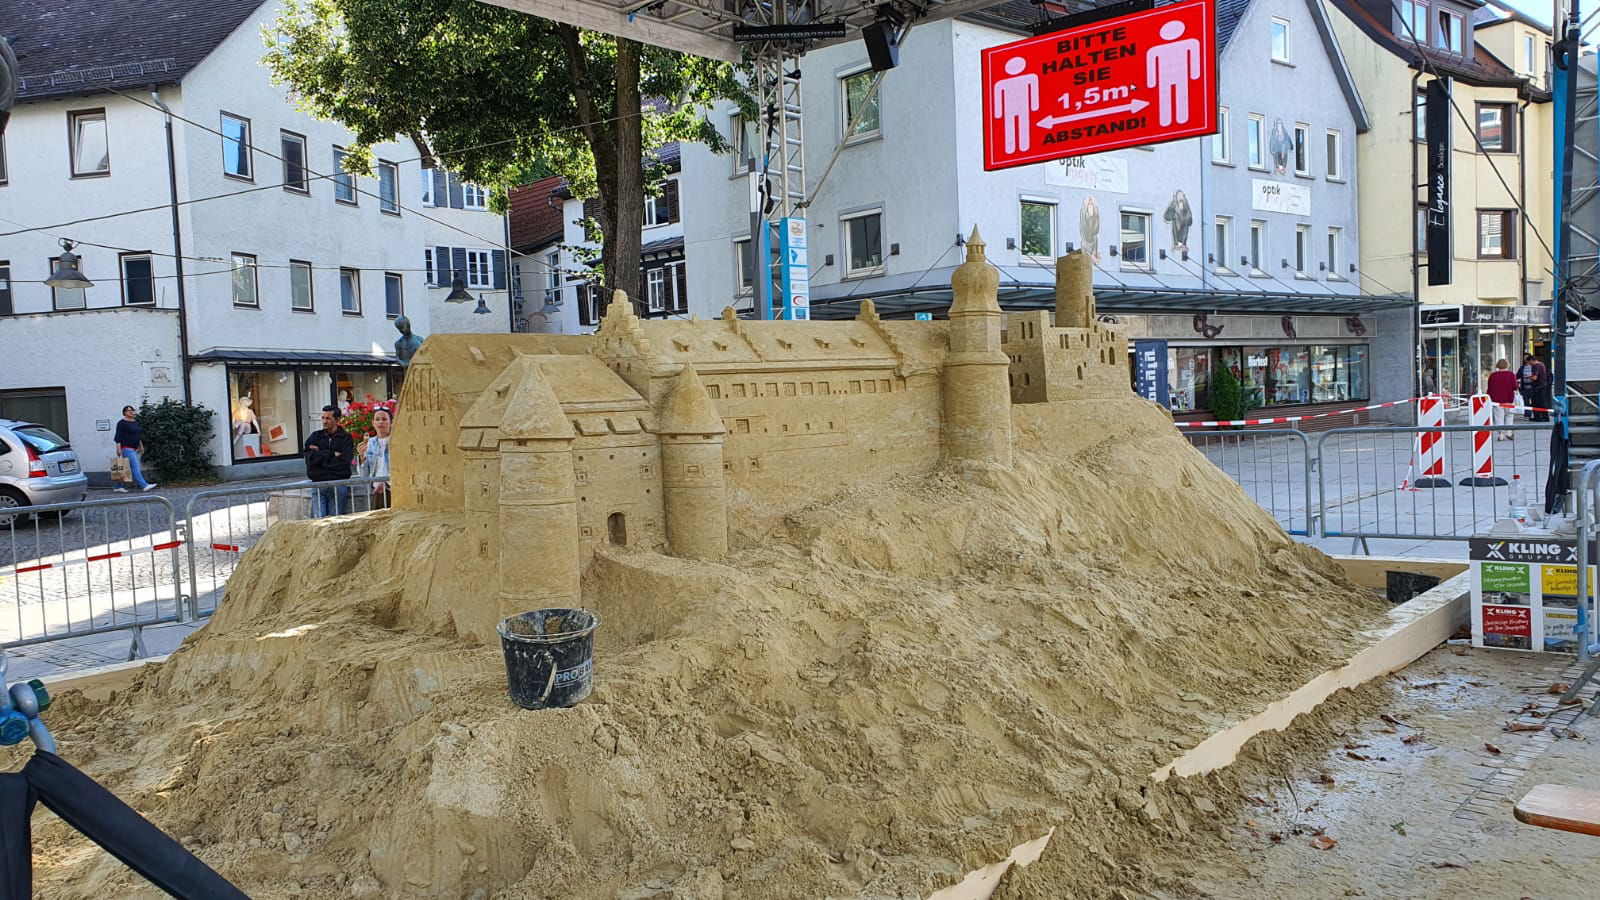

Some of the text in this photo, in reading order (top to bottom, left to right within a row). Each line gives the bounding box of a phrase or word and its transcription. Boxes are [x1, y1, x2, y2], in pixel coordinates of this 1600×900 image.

[1057, 26, 1127, 54] BITTE
[1042, 43, 1136, 74] HALTEN
[1073, 66, 1111, 86] SIE
[1057, 85, 1128, 111] 1,5m
[1042, 116, 1147, 145] ABSTAND!
[1059, 155, 1086, 176] optik
[1262, 184, 1281, 203] optik
[1428, 174, 1449, 226] Elegance
[1508, 543, 1561, 555] KLING
